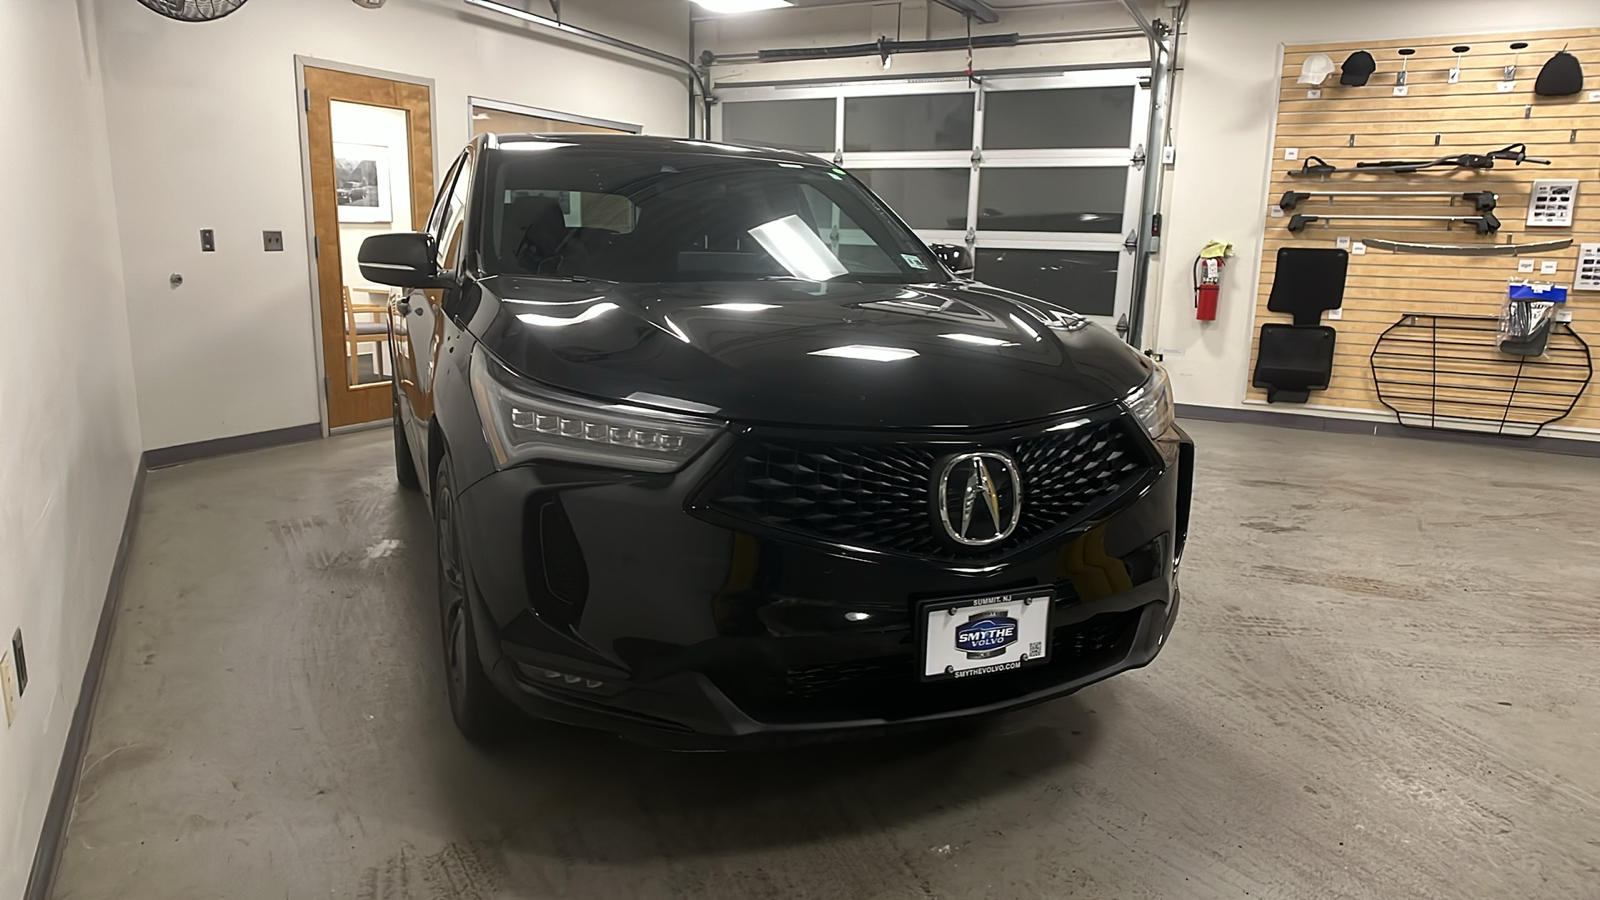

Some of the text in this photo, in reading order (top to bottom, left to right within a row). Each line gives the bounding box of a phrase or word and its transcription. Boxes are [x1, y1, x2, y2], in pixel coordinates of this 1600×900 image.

[959, 627, 1014, 642] SMYTHE
[971, 637, 1005, 647] VOLVO
[954, 662, 1021, 678] SMYTHEVOLVO.COM
